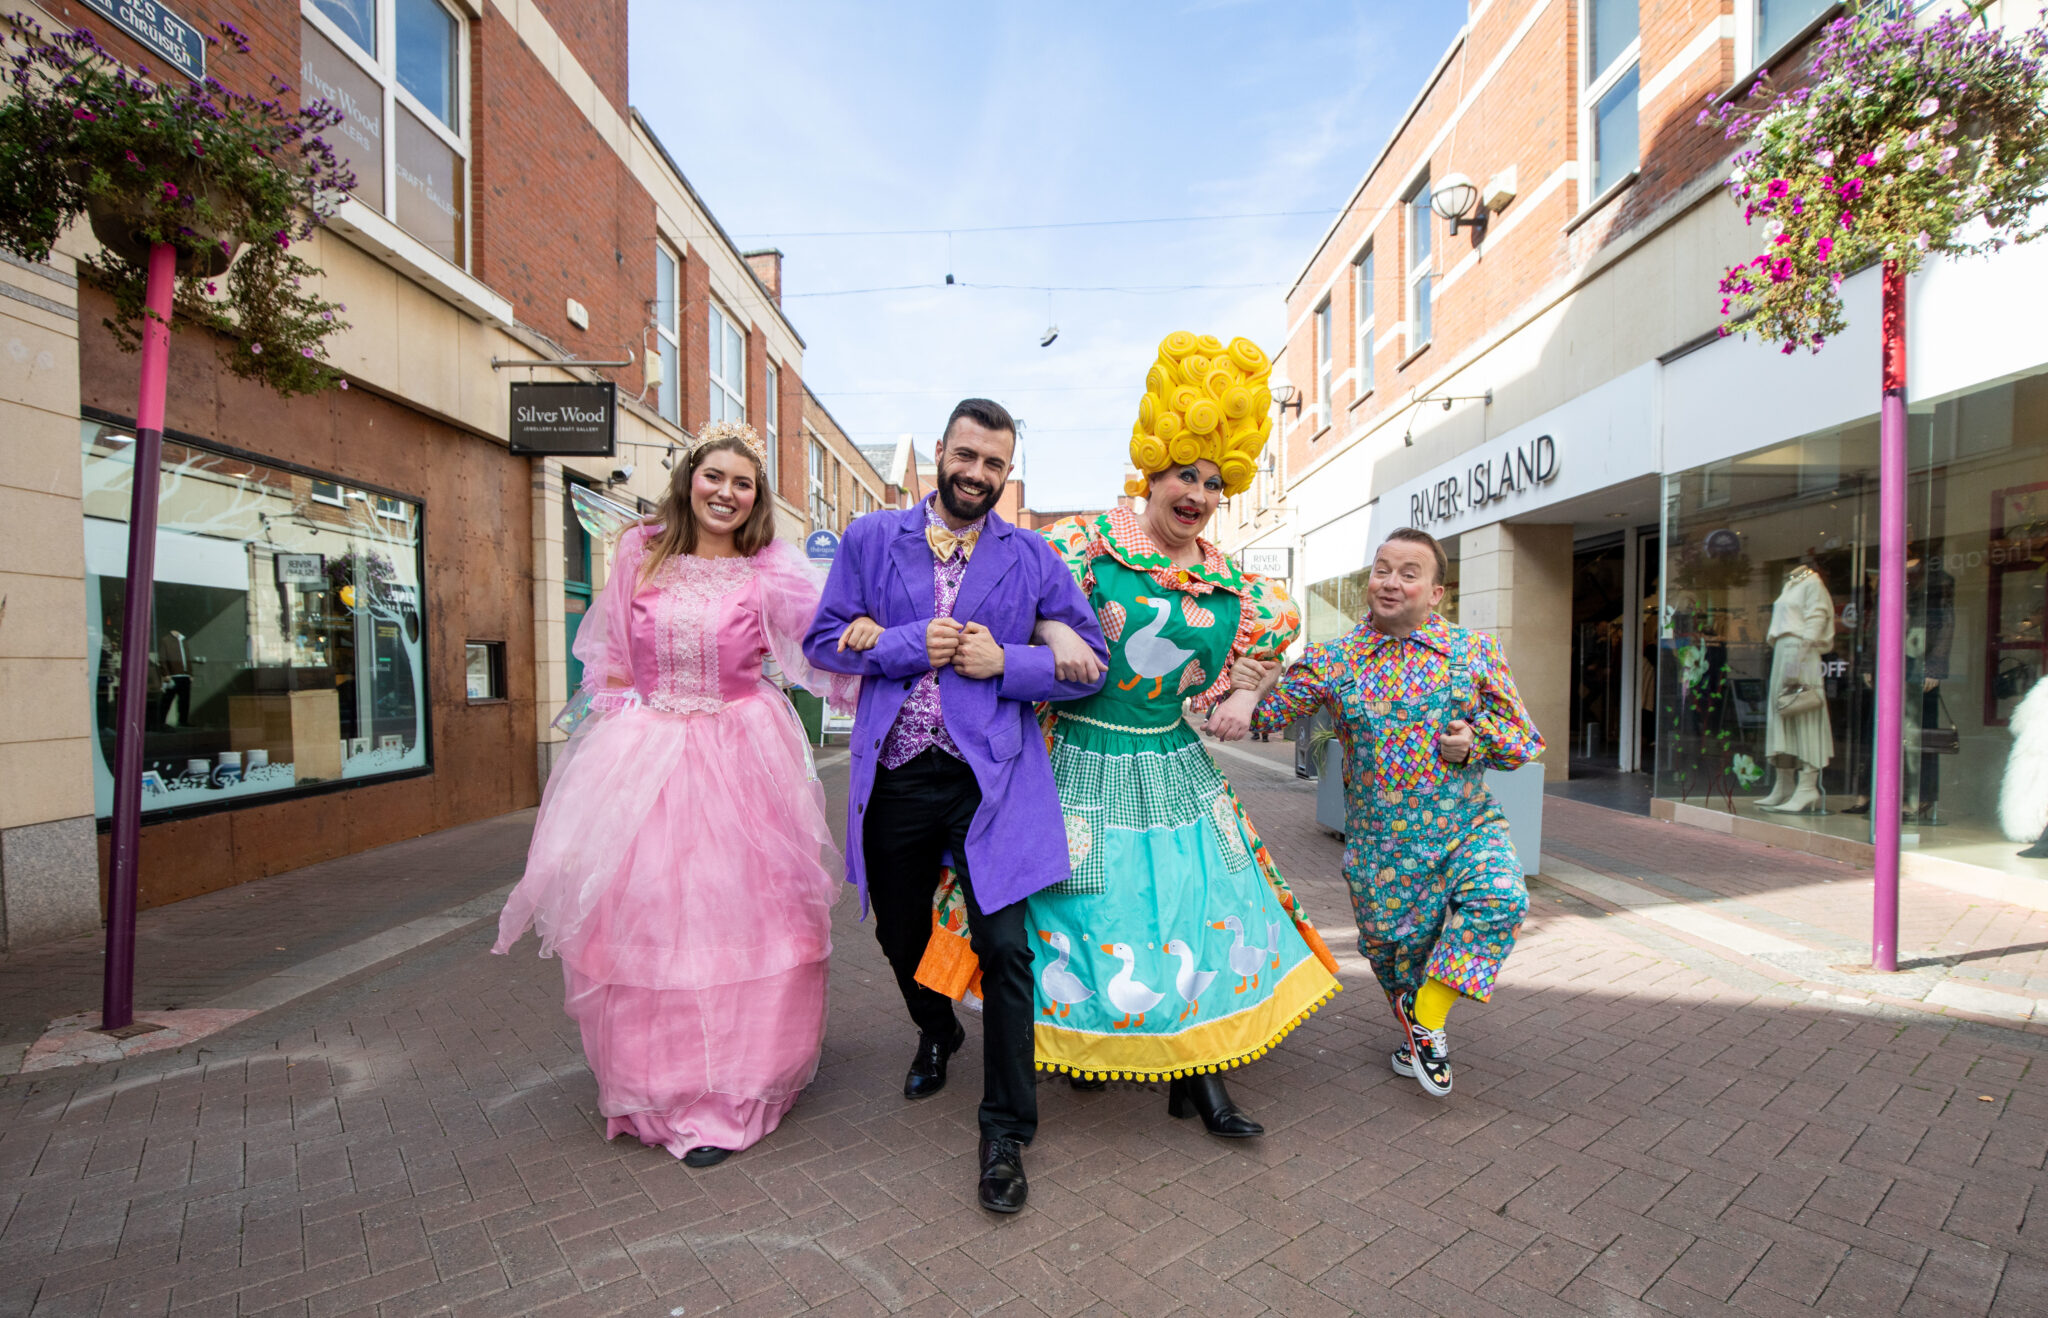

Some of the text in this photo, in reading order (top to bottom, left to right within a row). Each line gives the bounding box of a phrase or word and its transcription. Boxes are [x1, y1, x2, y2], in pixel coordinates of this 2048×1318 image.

[337, 86, 380, 140] Wood
[396, 163, 462, 222] CRAFT GALLERY
[517, 406, 605, 422] Silver Wood
[1411, 434, 1555, 529] RIVER ISLAND
[1253, 554, 1278, 562] RIVER
